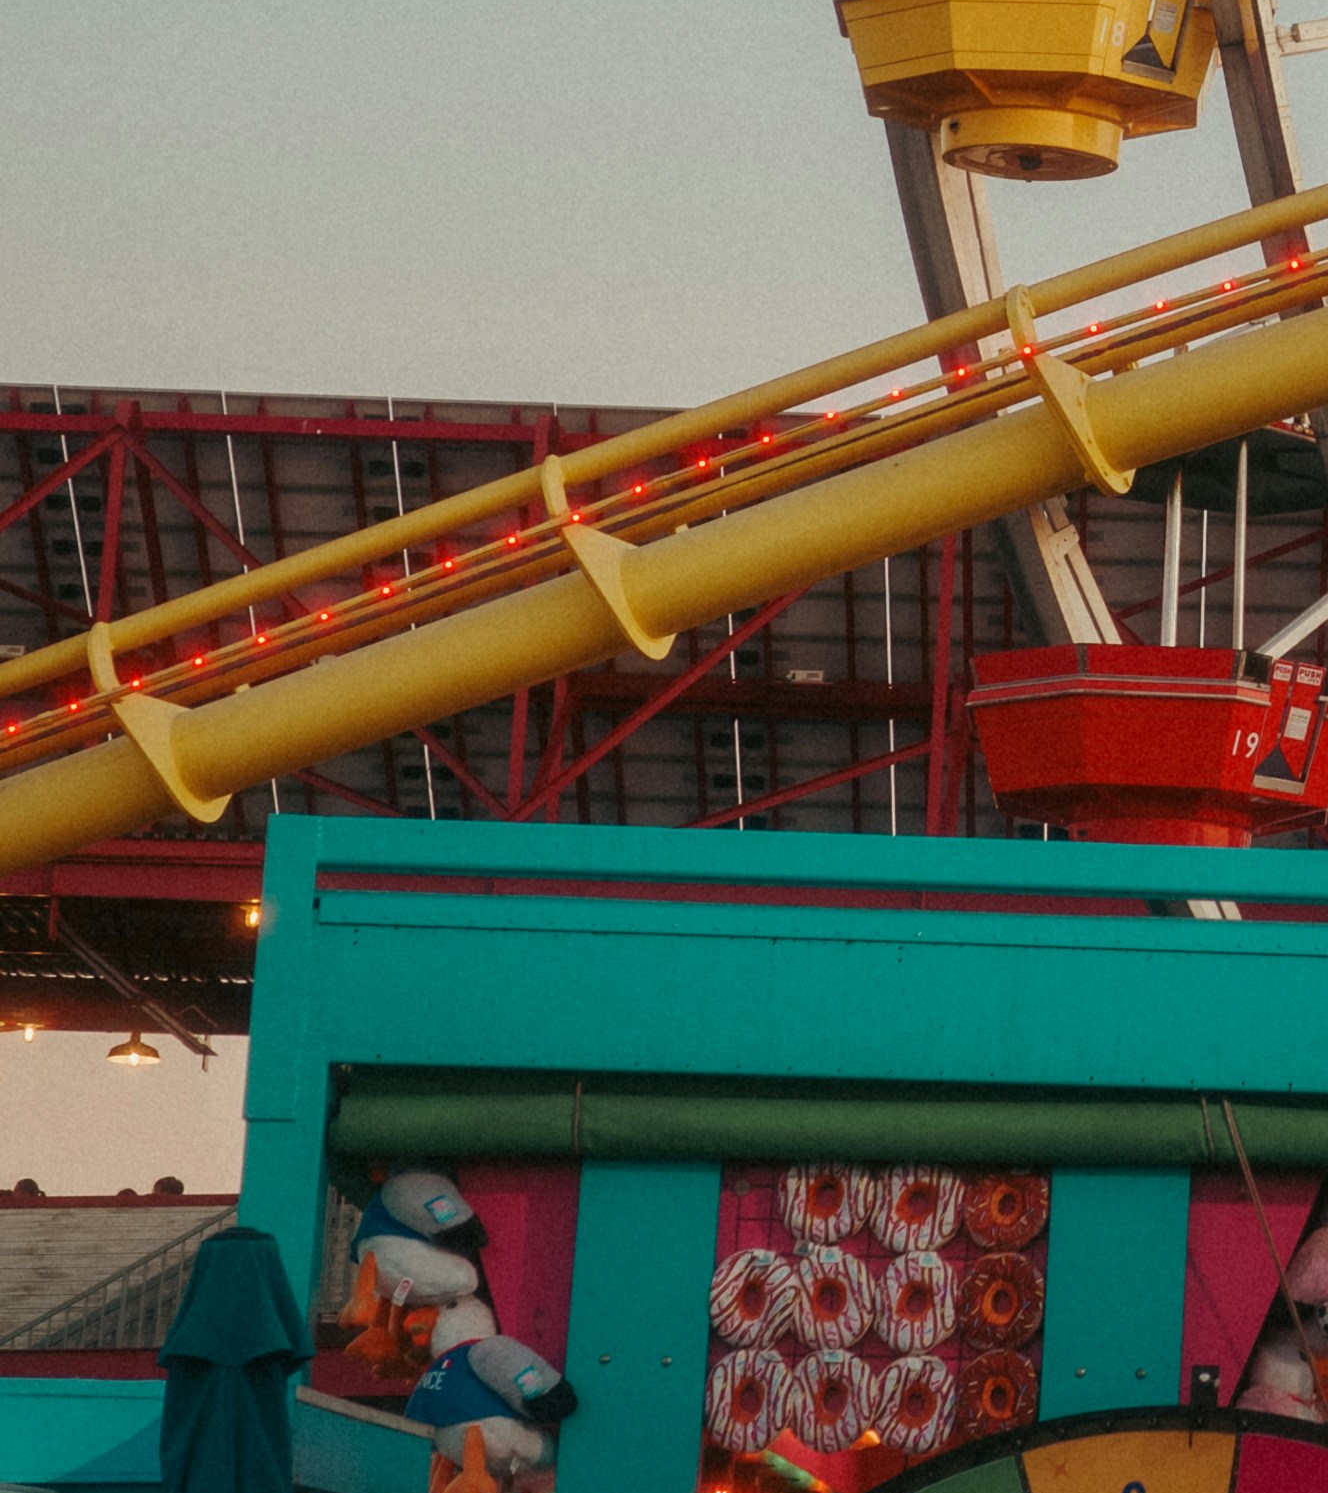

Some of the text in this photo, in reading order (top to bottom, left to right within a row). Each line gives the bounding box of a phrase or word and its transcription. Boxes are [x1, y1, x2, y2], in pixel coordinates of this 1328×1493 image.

[1099, 16, 1127, 47] 18
[1298, 668, 1322, 679] PUSH
[1232, 729, 1260, 759] 19
